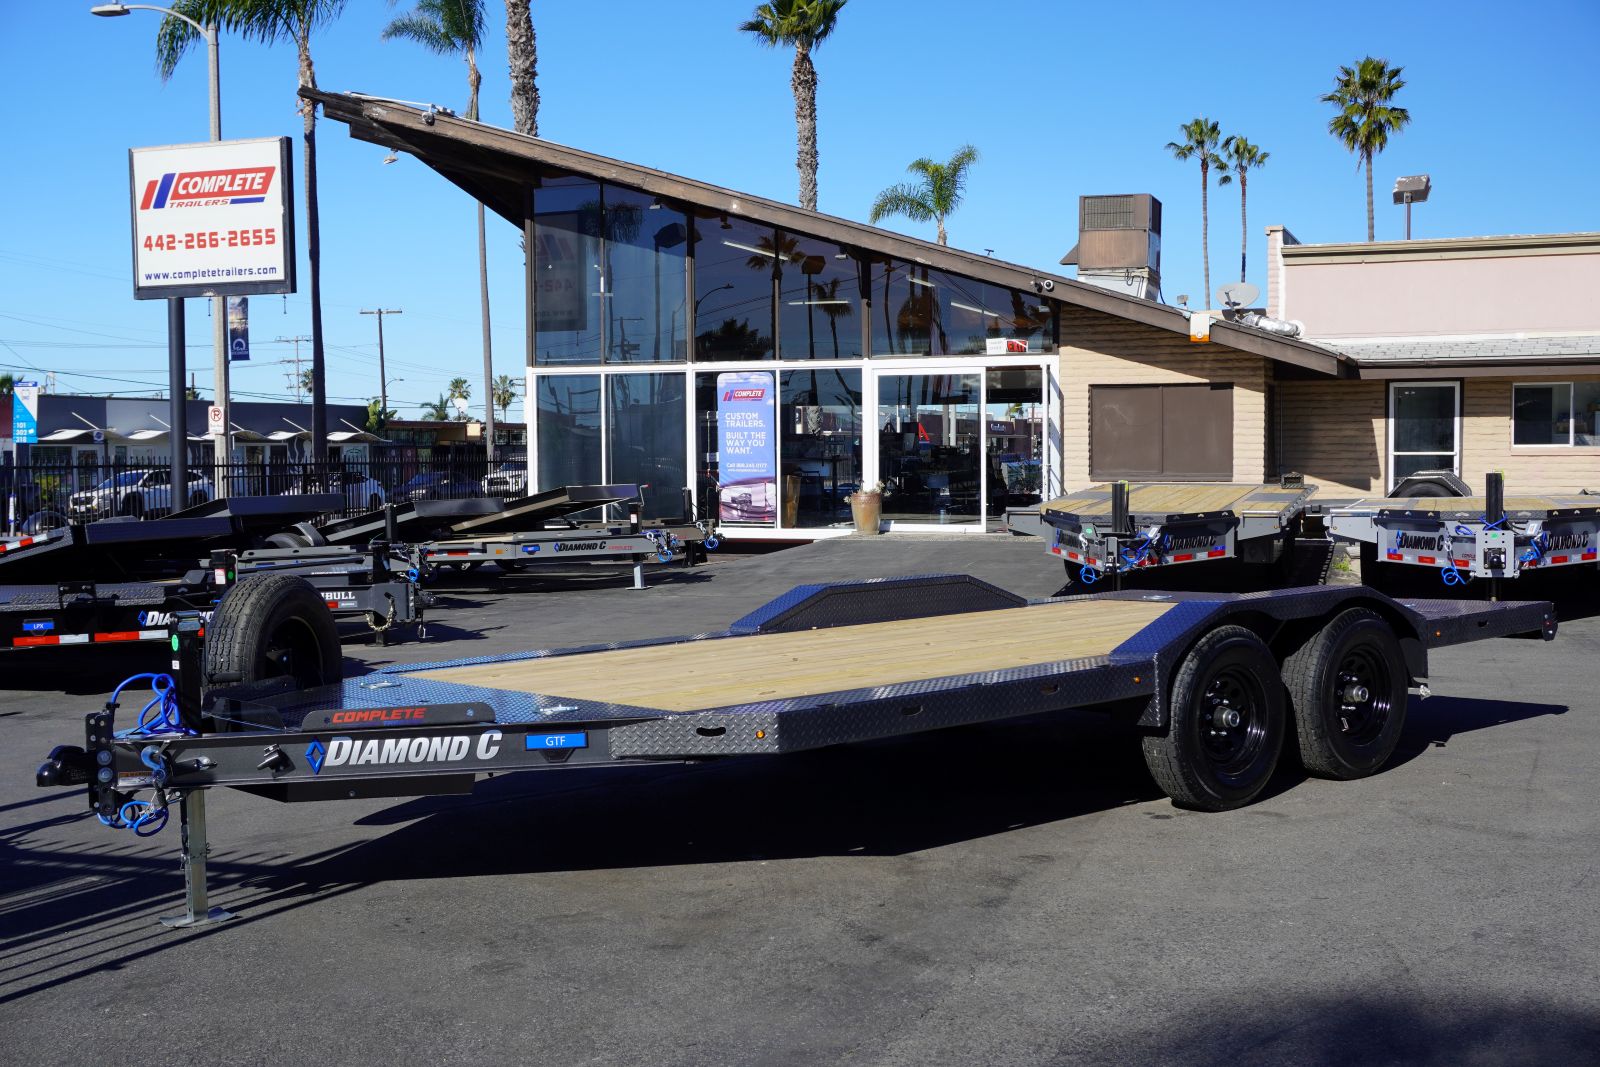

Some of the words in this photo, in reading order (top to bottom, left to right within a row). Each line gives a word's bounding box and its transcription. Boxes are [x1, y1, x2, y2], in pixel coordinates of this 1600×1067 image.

[178, 172, 266, 195] COMPLETE
[169, 198, 229, 208] TRAILERS
[143, 228, 276, 251] 442-266-2655
[144, 266, 277, 280] www.completetrailers.com
[725, 412, 759, 420] CUSTOM
[725, 420, 766, 428] TRAILERS.
[726, 432, 748, 440] BUILT
[726, 447, 753, 455] WANT.
[1401, 532, 1436, 551] DIAMOND
[1436, 535, 1445, 551] C
[1581, 531, 1589, 547] C
[559, 541, 598, 552] DIAMOND
[599, 541, 607, 550] C
[332, 707, 427, 724] COMPLETE
[545, 736, 566, 747] GTF
[324, 737, 471, 767] DIAMOND
[476, 729, 503, 760] C
